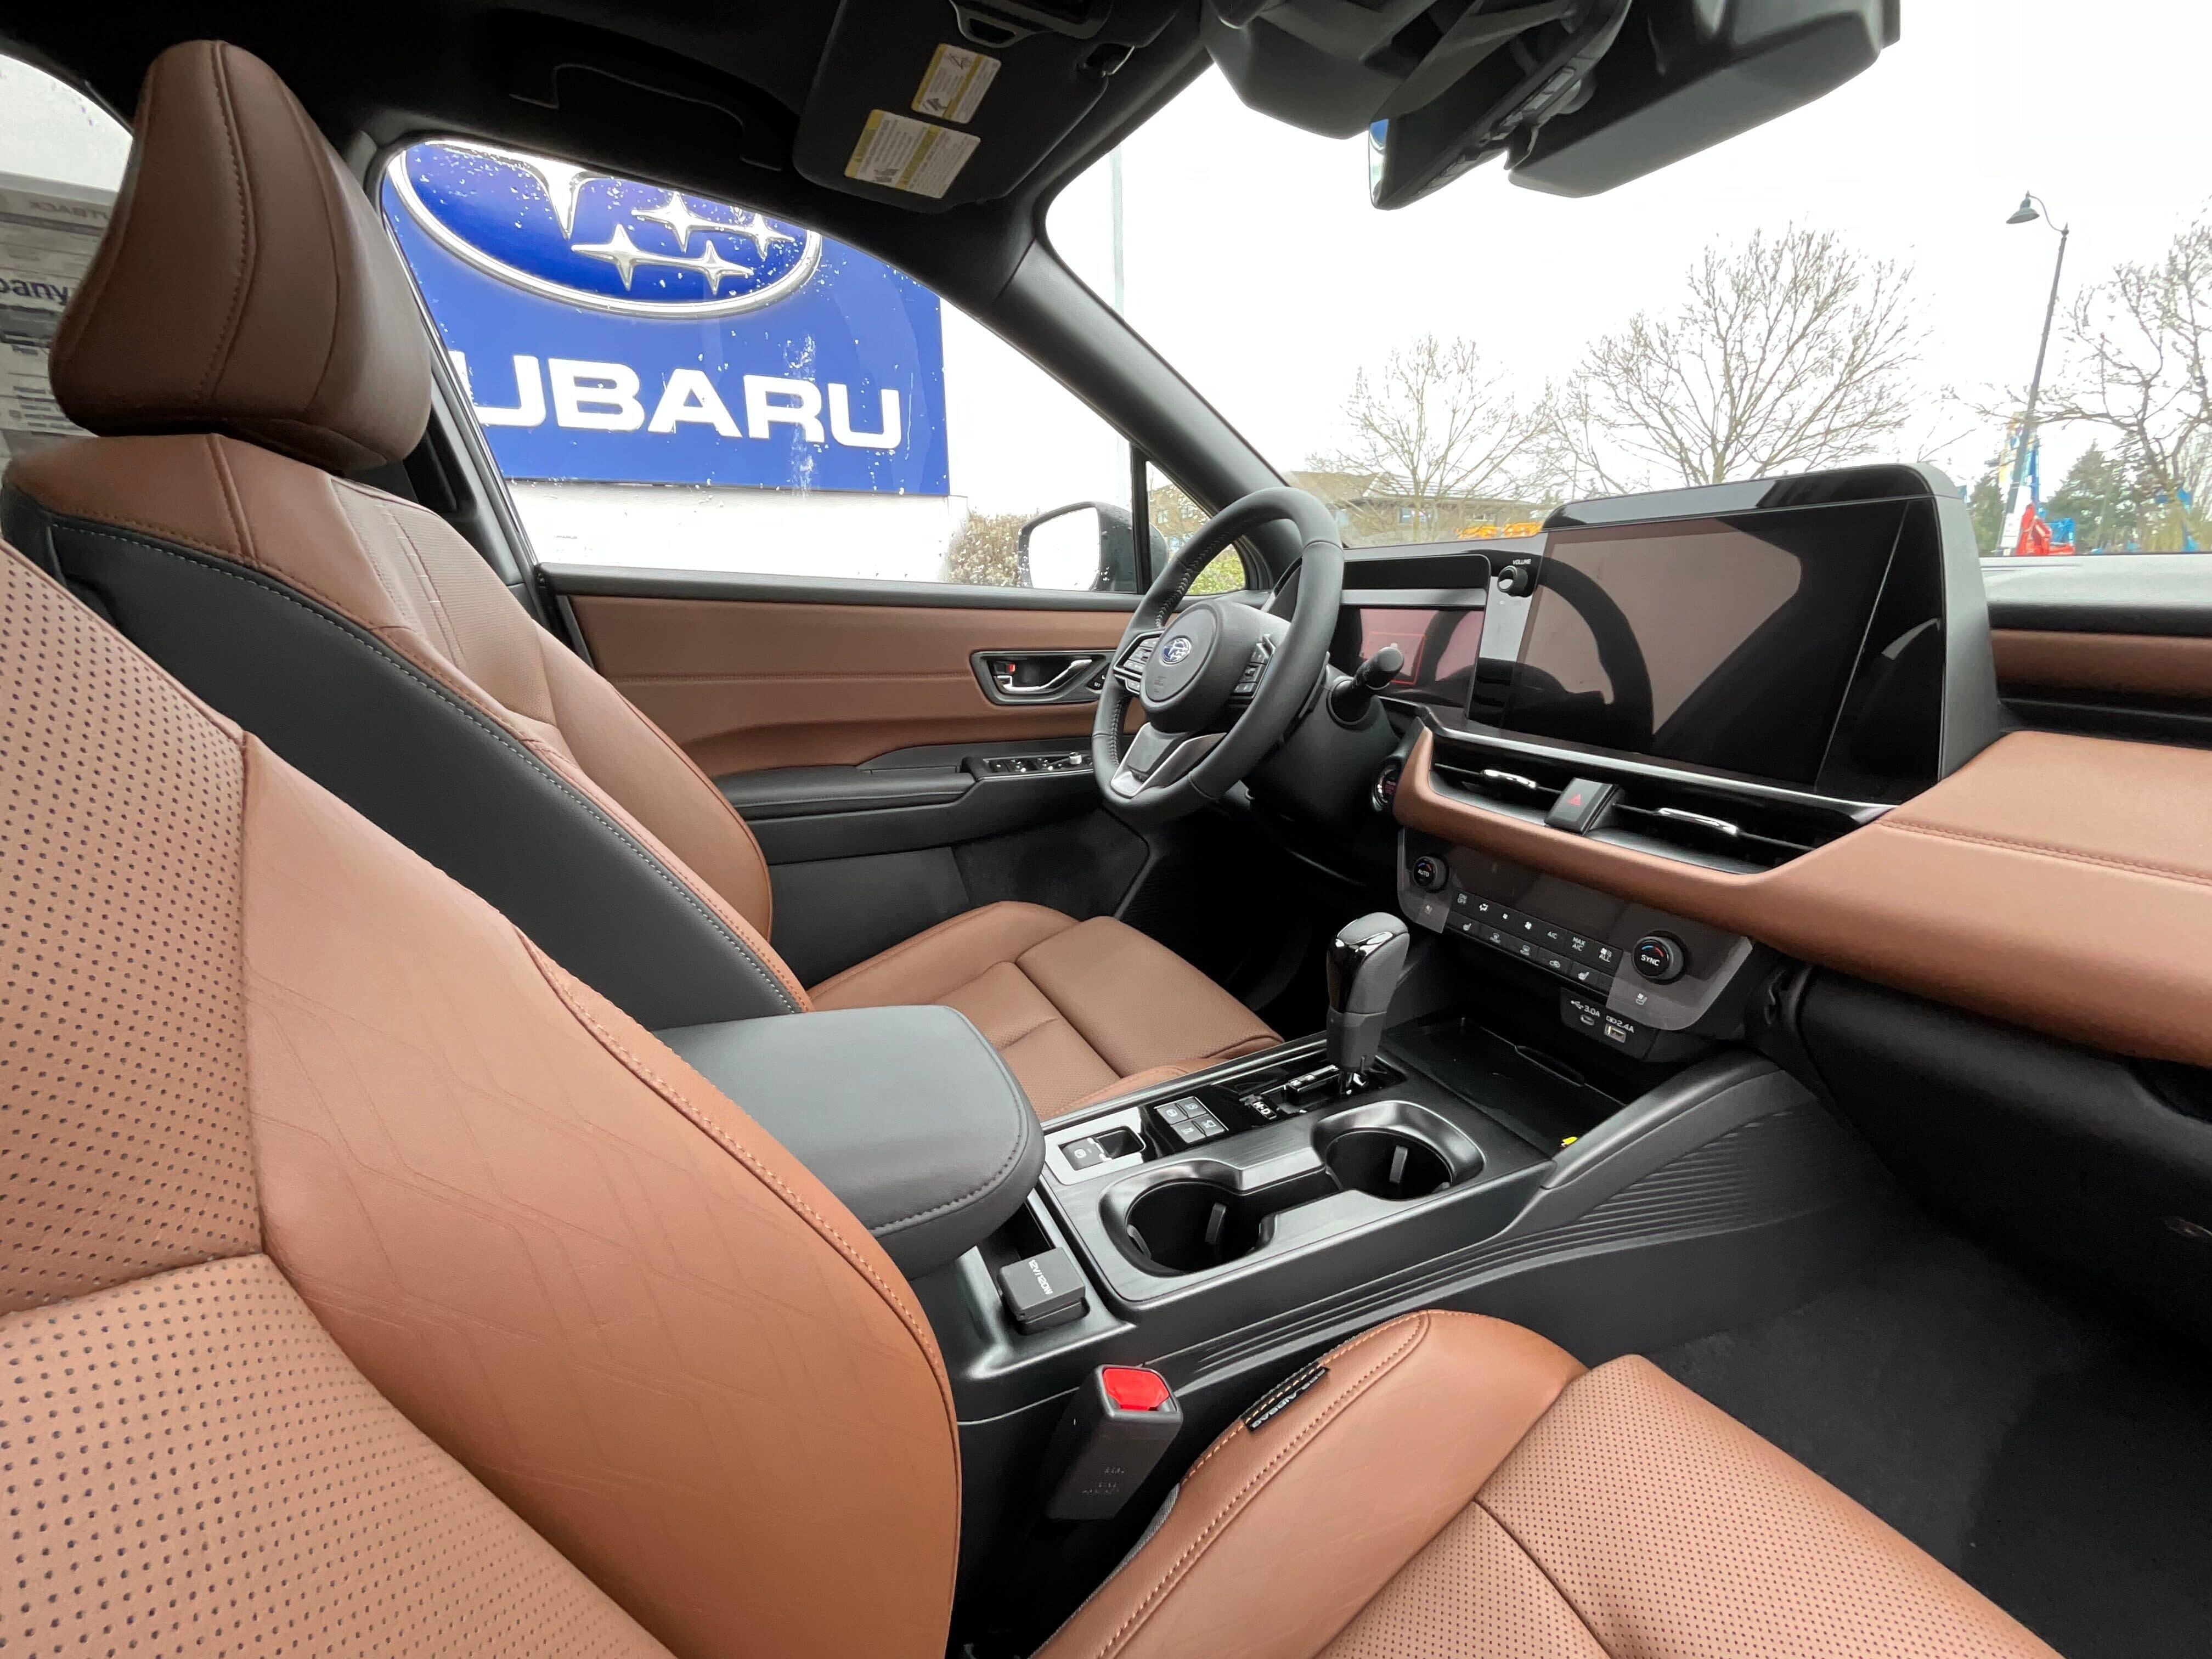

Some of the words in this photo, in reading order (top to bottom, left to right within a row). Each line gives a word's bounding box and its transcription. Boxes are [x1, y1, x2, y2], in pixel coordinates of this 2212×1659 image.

[1418, 868, 1430, 877] AUTO
[1572, 937, 1586, 946] MAX
[1571, 943, 1583, 951] A/C
[1599, 953, 1611, 963] ALL
[1641, 954, 1660, 967] SYNC
[1616, 1020, 1635, 1034] 2.4A
